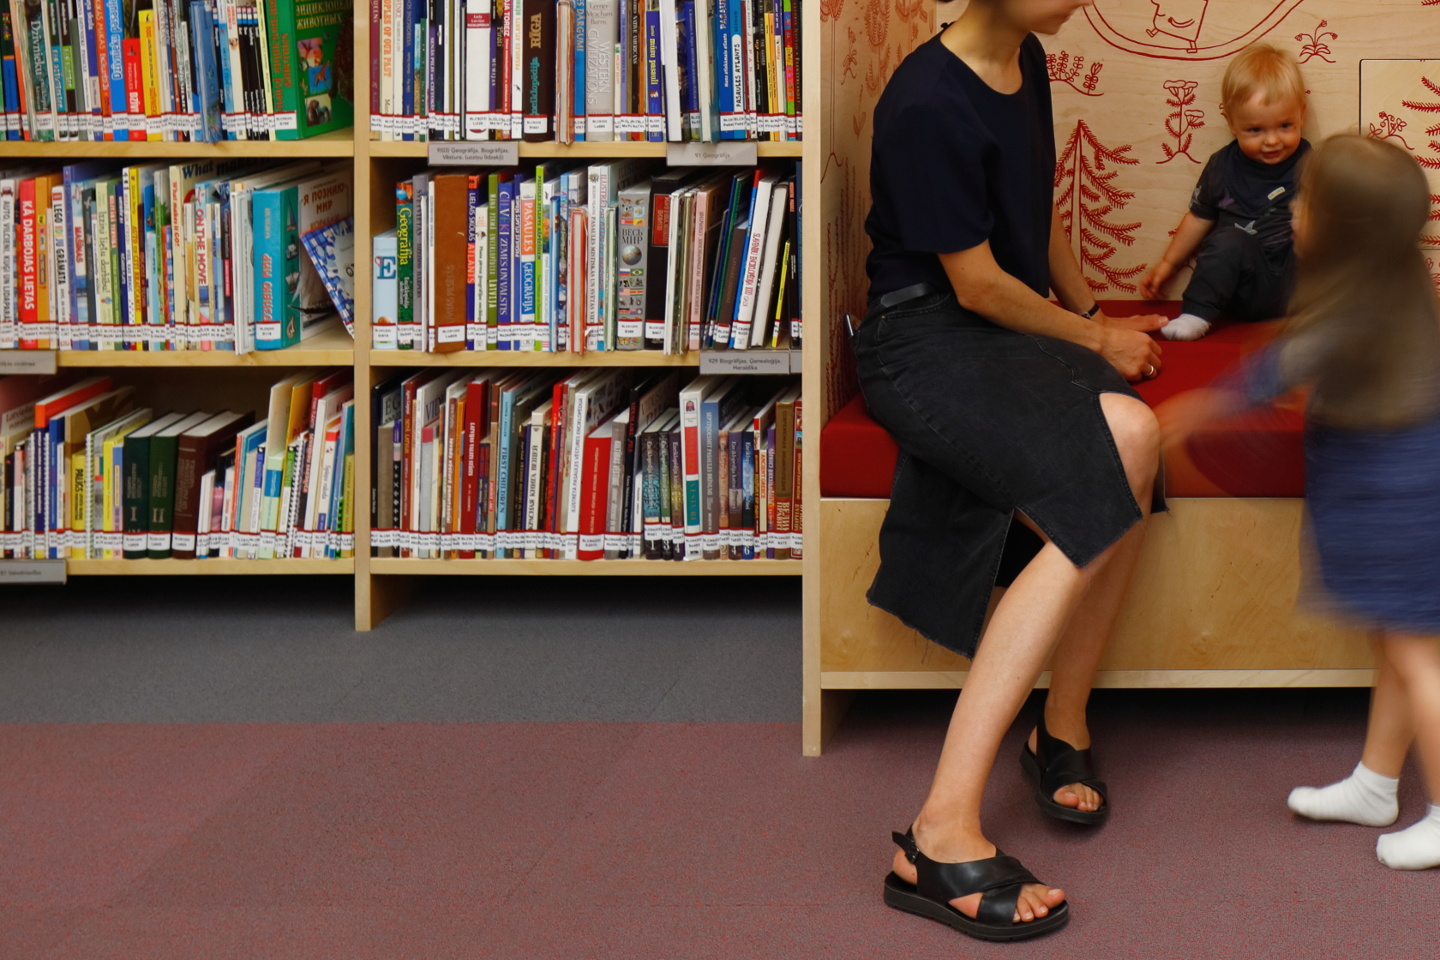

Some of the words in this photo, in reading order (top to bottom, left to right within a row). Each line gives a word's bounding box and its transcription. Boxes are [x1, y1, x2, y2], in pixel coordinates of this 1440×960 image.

[577, 8, 585, 52] DĀRGUMI
[22, 200, 33, 216] KĀ
[524, 201, 532, 251] PASAULES
[22, 219, 34, 273] DARBOJAS
[196, 226, 205, 248] THE
[197, 252, 207, 284] MOVE
[467, 242, 475, 284] ATLANTS
[23, 275, 35, 309] LIETAS
